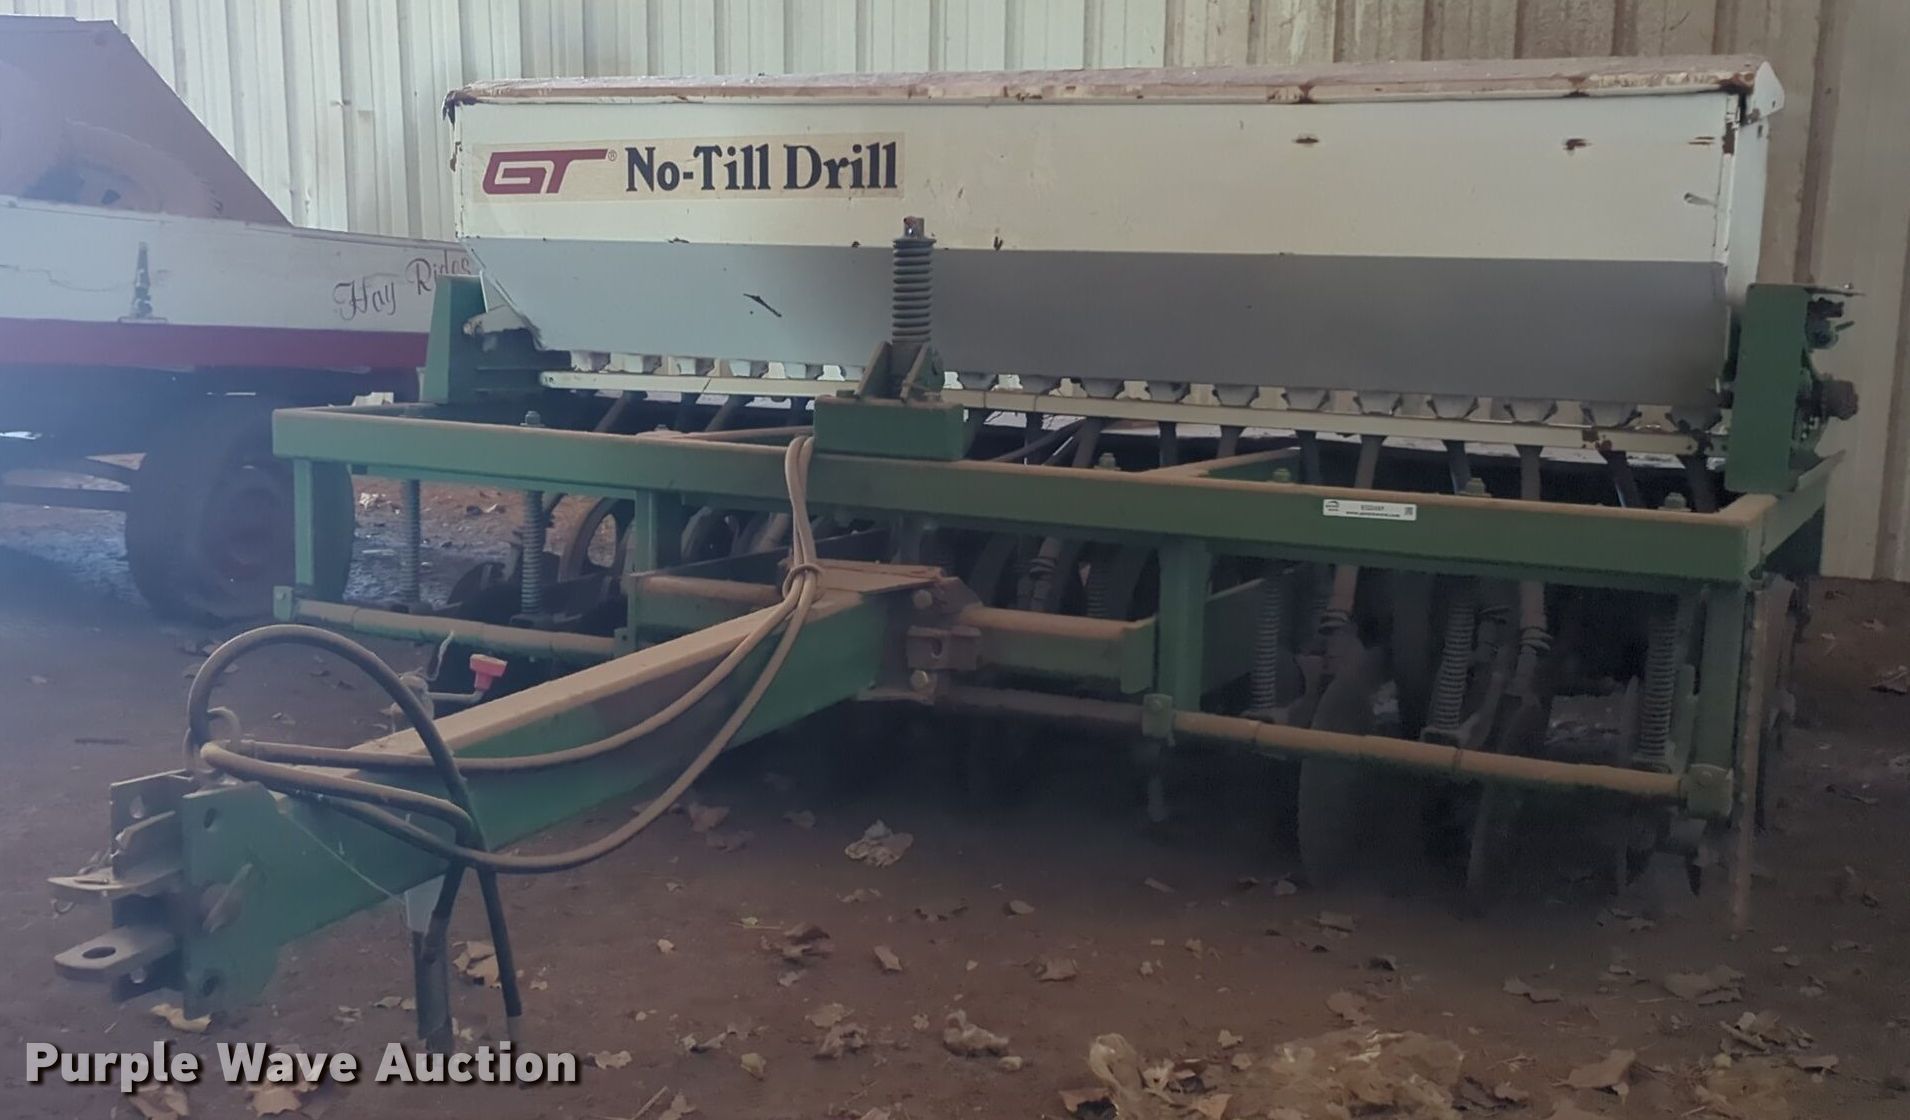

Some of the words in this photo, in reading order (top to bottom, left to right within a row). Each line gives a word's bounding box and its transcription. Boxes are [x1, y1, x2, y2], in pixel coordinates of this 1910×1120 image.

[625, 142, 771, 192] No-Till
[784, 140, 898, 190] Drill
[333, 275, 397, 321] Hay
